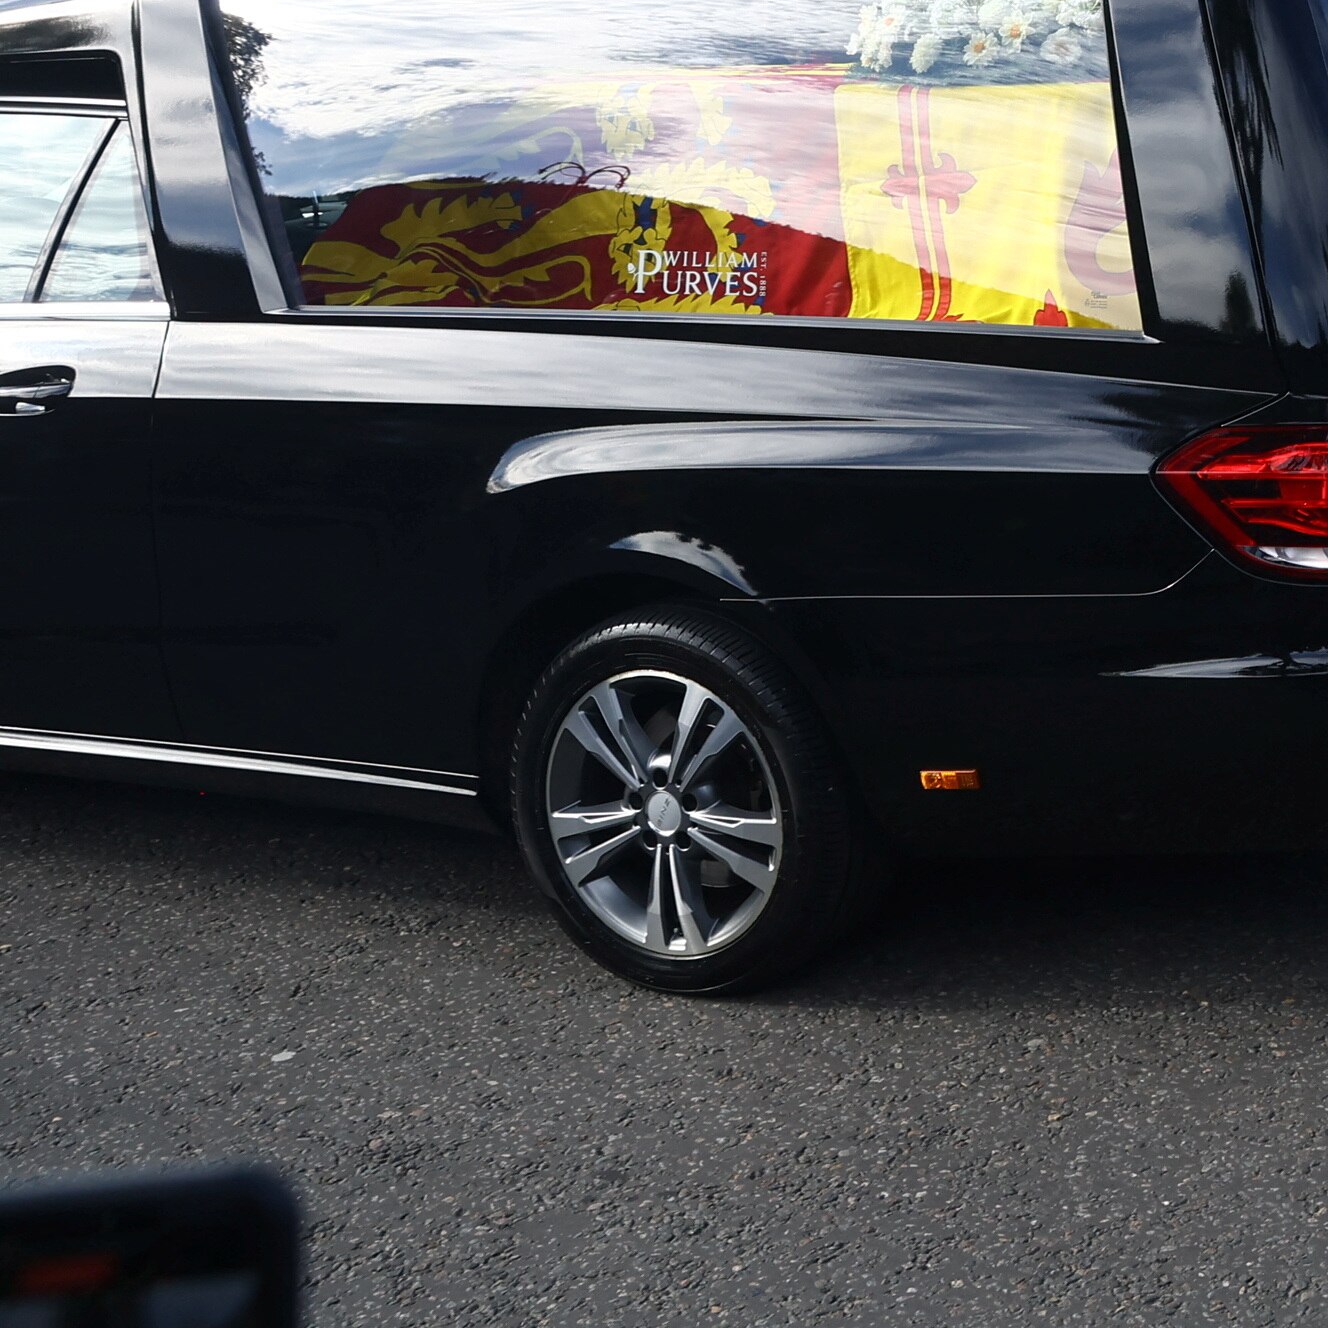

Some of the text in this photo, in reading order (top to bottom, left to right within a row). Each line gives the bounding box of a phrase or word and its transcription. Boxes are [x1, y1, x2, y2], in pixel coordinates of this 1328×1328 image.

[634, 250, 758, 296] PURVES
[662, 250, 758, 268] WILLIAM
[759, 251, 768, 297] EST. 1888
